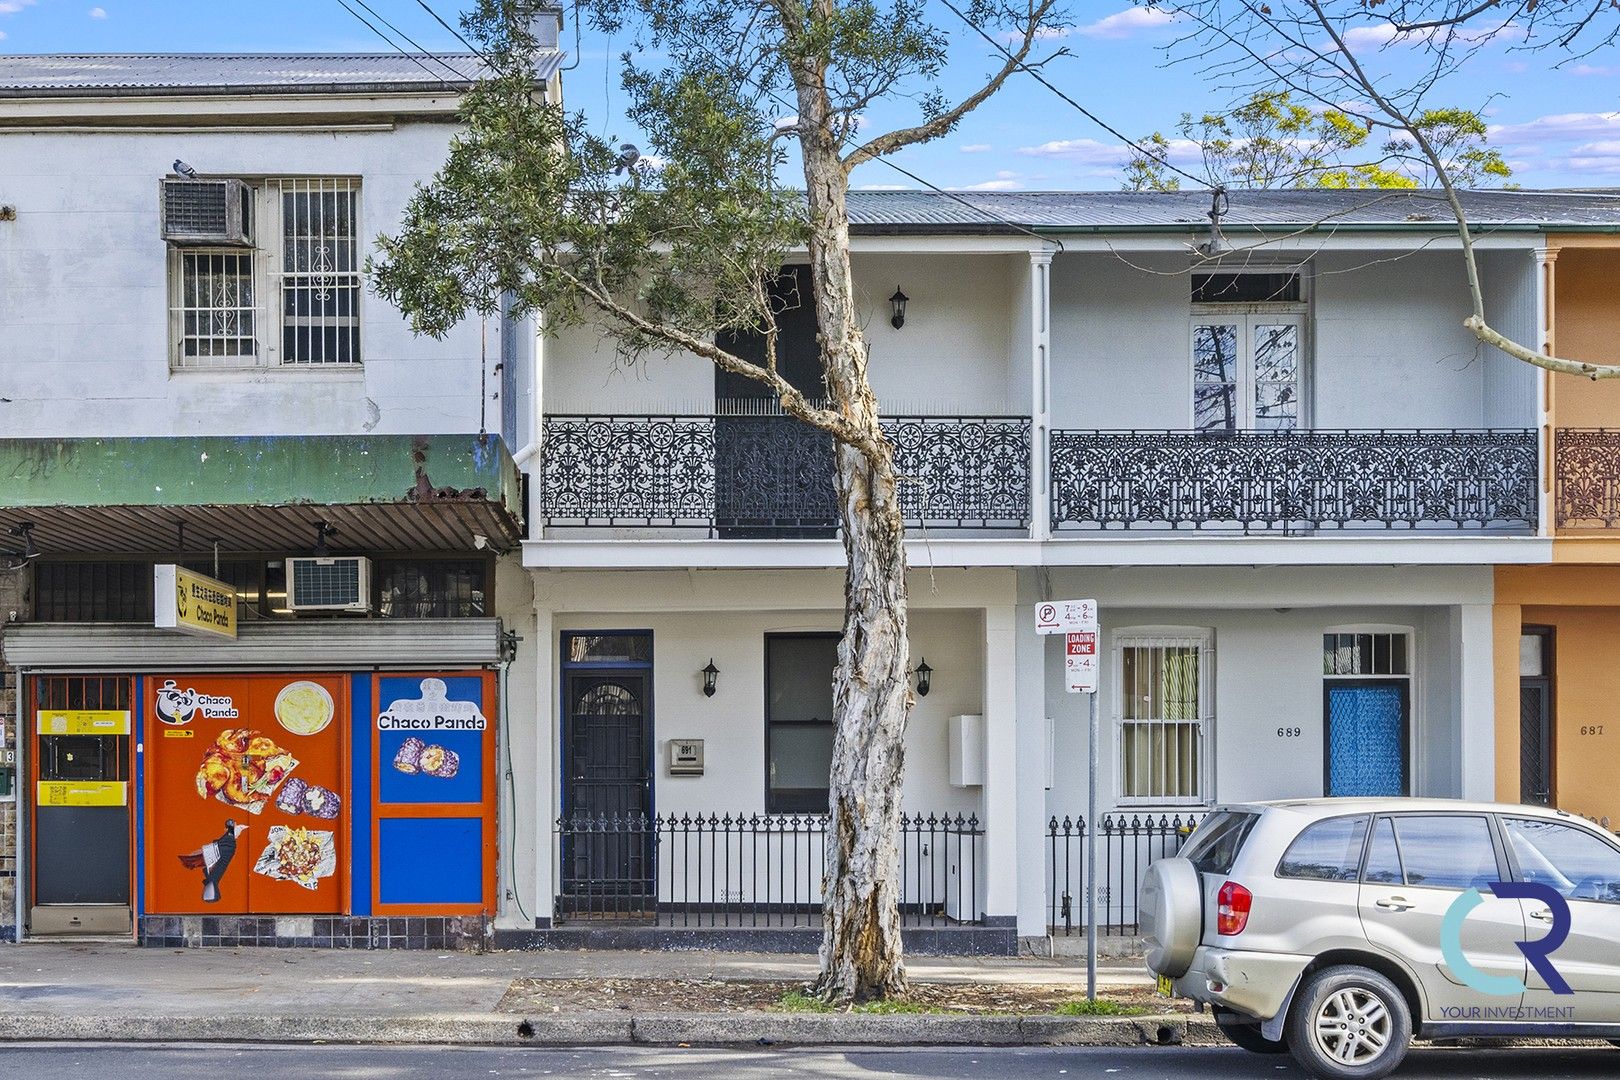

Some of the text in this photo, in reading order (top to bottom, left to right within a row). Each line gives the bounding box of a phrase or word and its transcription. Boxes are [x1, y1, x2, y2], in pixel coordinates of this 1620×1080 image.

[197, 605, 229, 627] Chaco Panda
[1068, 634, 1094, 643] LOADING
[1071, 644, 1092, 653] ZONE
[197, 696, 231, 705] Chaco
[205, 708, 238, 717] Panda
[379, 715, 485, 729] Chaco Panda
[1277, 727, 1301, 737] 689
[1580, 725, 1604, 736] 687
[681, 745, 692, 754] 691
